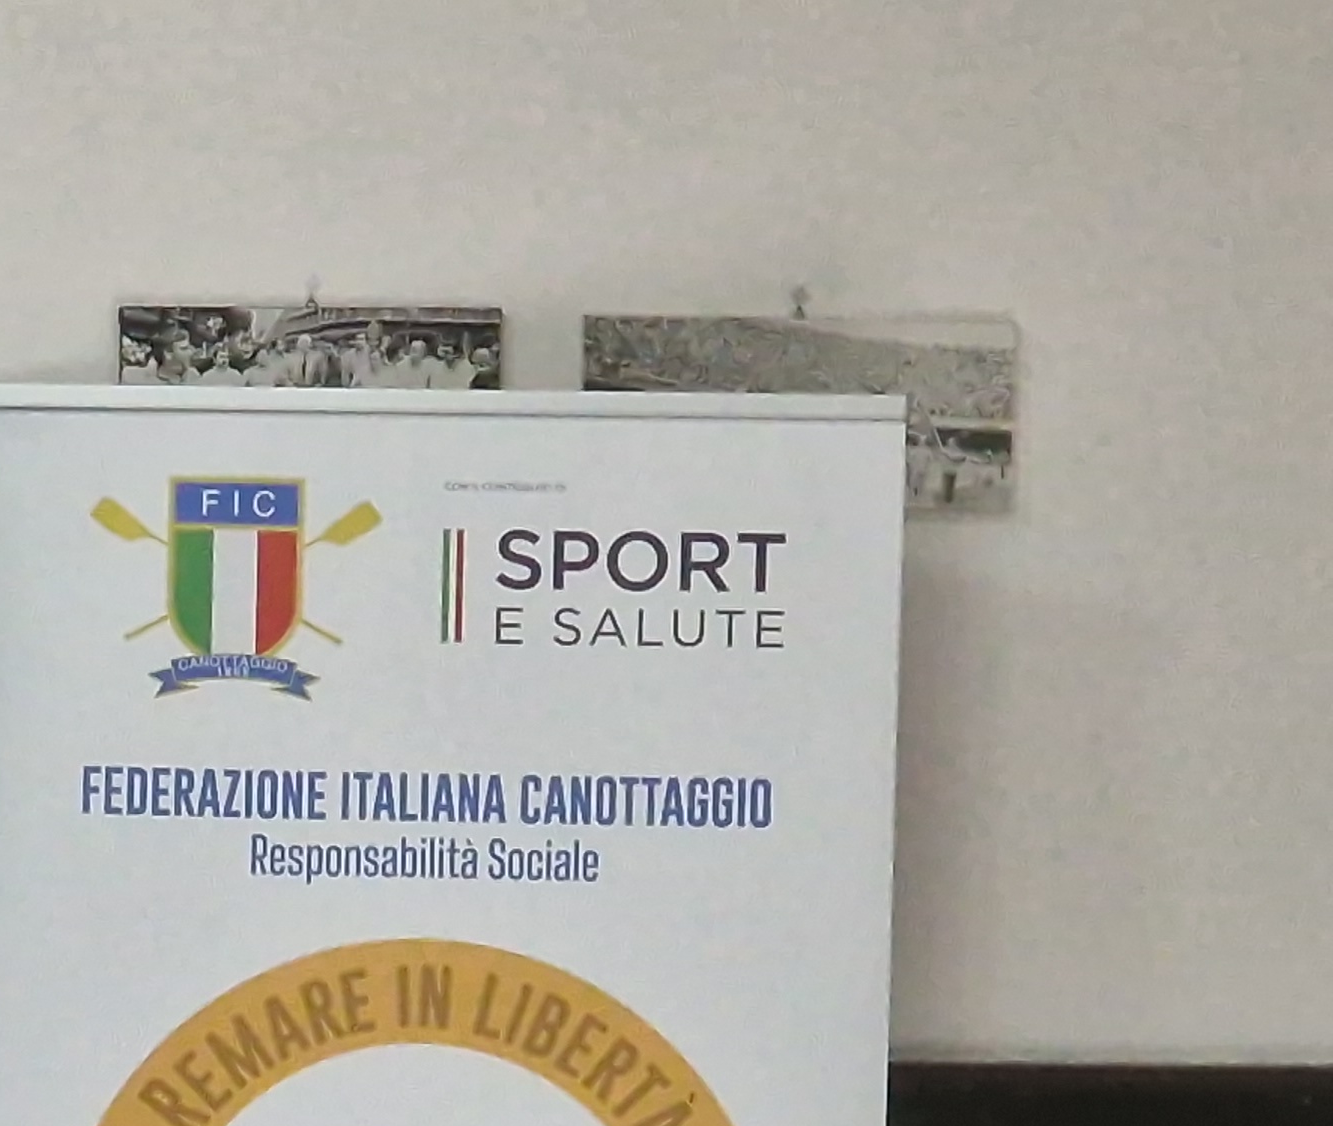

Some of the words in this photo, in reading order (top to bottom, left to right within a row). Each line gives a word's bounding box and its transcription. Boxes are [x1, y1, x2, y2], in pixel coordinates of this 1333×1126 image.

[495, 529, 788, 594] SPORT
[496, 608, 524, 647] E
[553, 607, 787, 650] SALUTE
[80, 764, 327, 822] FEDERAZIONE
[340, 770, 507, 825] ITALIANA
[519, 773, 774, 829] CANOTTAGGIO
[249, 834, 480, 886] Responsabilità
[487, 838, 600, 883] Sociale
[393, 963, 453, 1031] IN
